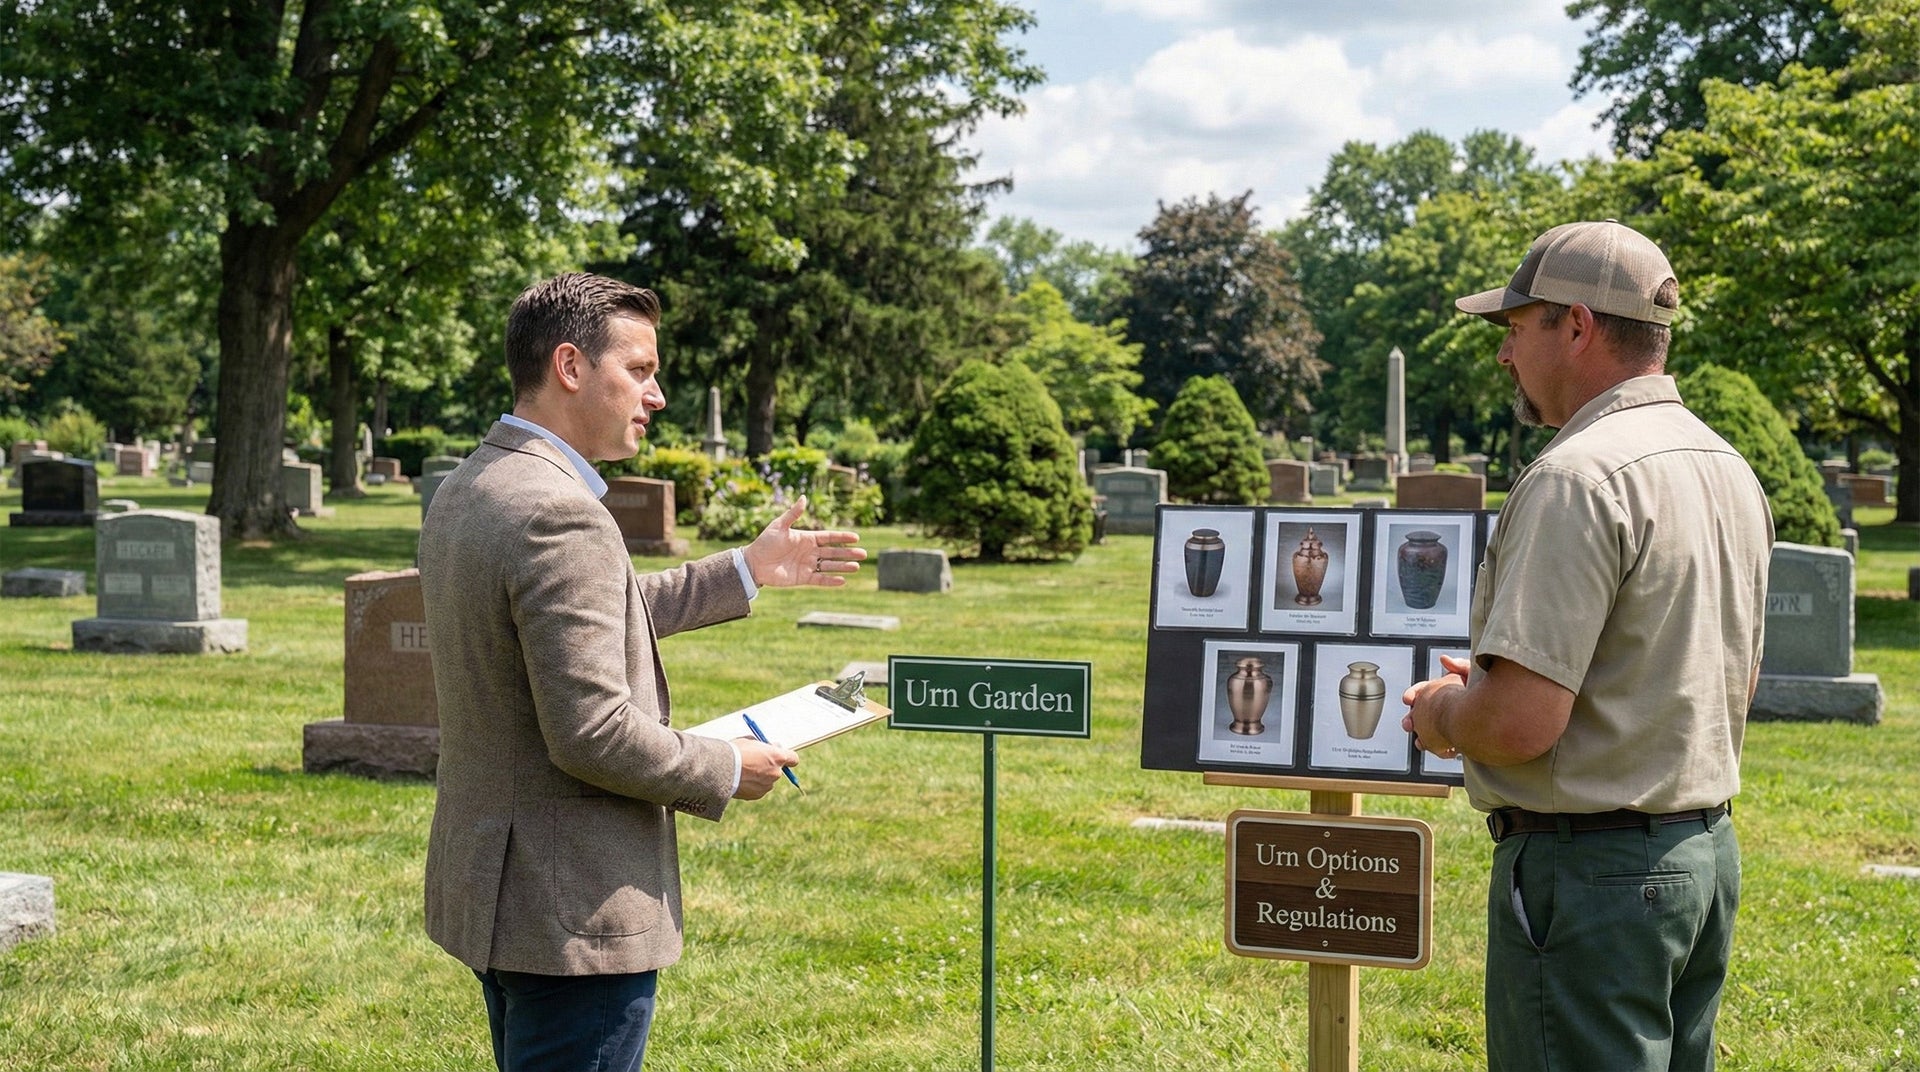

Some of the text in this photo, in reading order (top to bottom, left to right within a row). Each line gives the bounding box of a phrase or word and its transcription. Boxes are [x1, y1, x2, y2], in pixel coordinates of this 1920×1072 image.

[905, 679, 1074, 713] Urn Garden
[1256, 843, 1400, 876] Urn Options
[1315, 877, 1337, 900] &
[1256, 901, 1397, 933] Regulations
